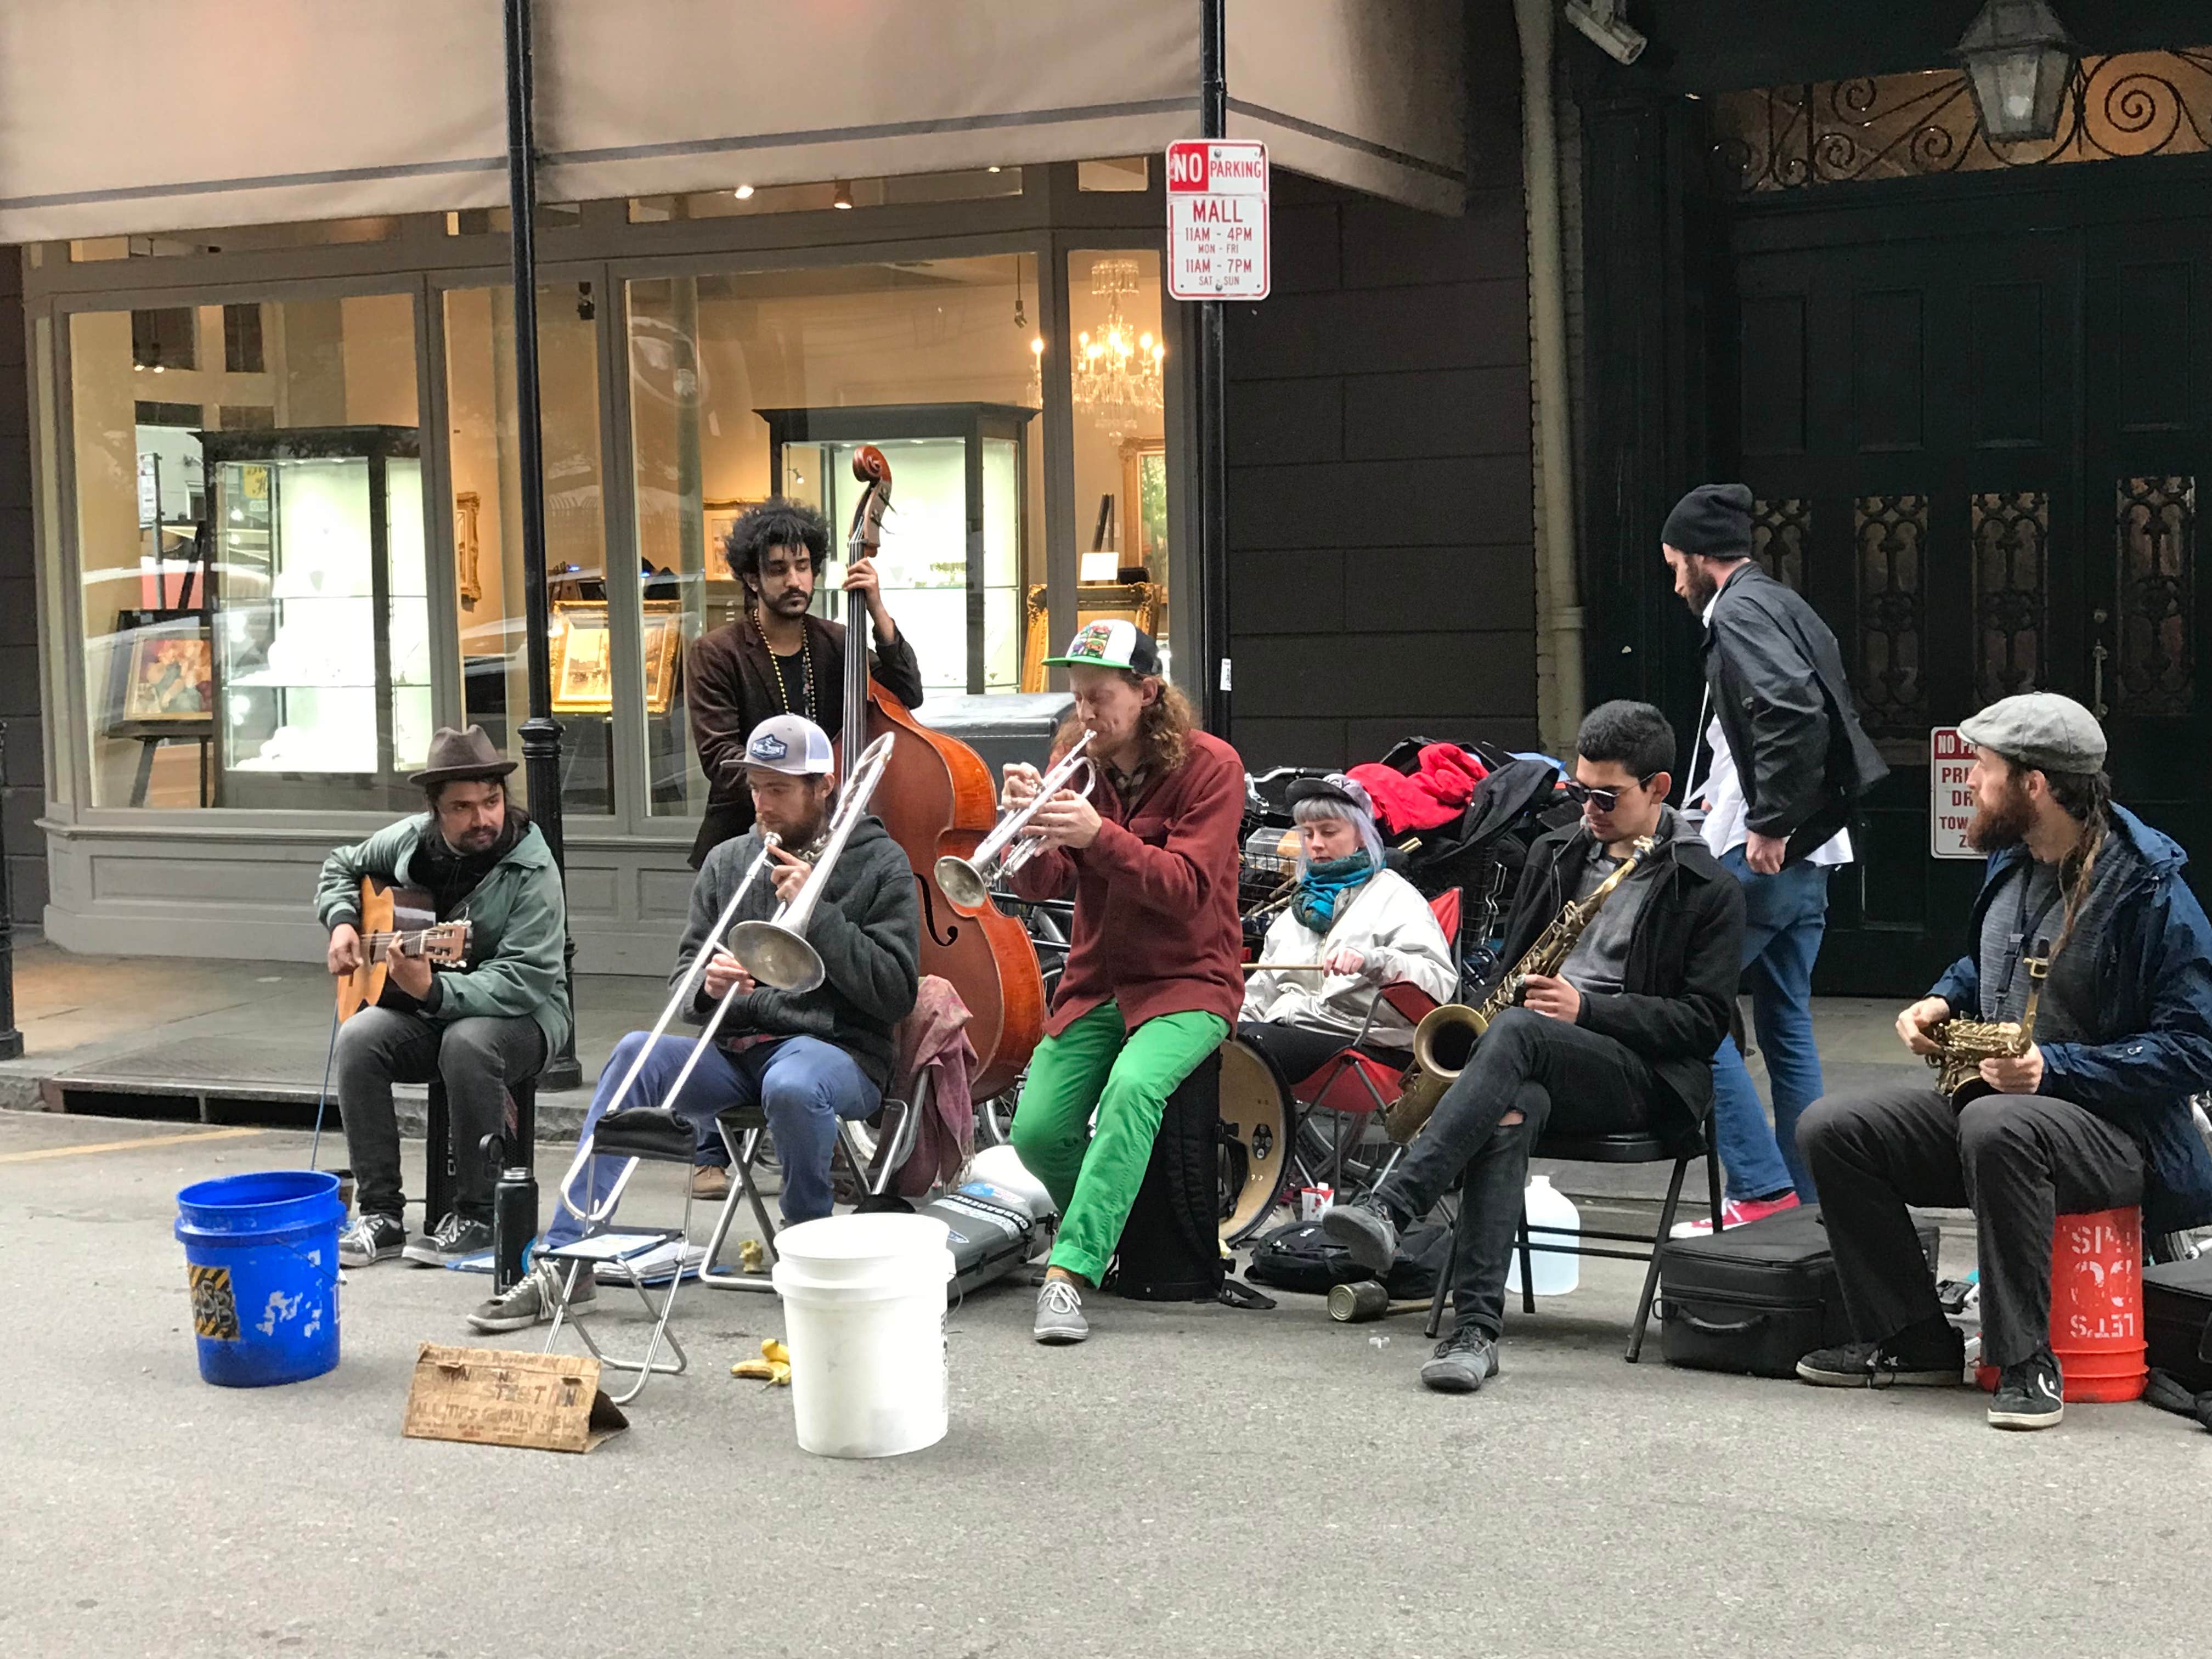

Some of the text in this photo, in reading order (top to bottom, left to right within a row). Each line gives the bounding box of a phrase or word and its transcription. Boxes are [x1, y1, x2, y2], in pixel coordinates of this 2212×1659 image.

[1172, 153, 1261, 183] NO PARKING
[1193, 200, 1243, 223] MALL
[1185, 227, 1210, 241] 11AM
[1227, 227, 1252, 241] 4PM
[1198, 244, 1215, 254] MON
[1226, 244, 1239, 253] FRI
[1186, 259, 1210, 273] 11AM
[1227, 258, 1252, 273] 7PM
[1199, 276, 1212, 286] SAT
[1224, 276, 1239, 285] SUN
[1938, 735, 1955, 754] NO
[1942, 767, 1970, 783] PRI
[1952, 790, 1974, 806] DR
